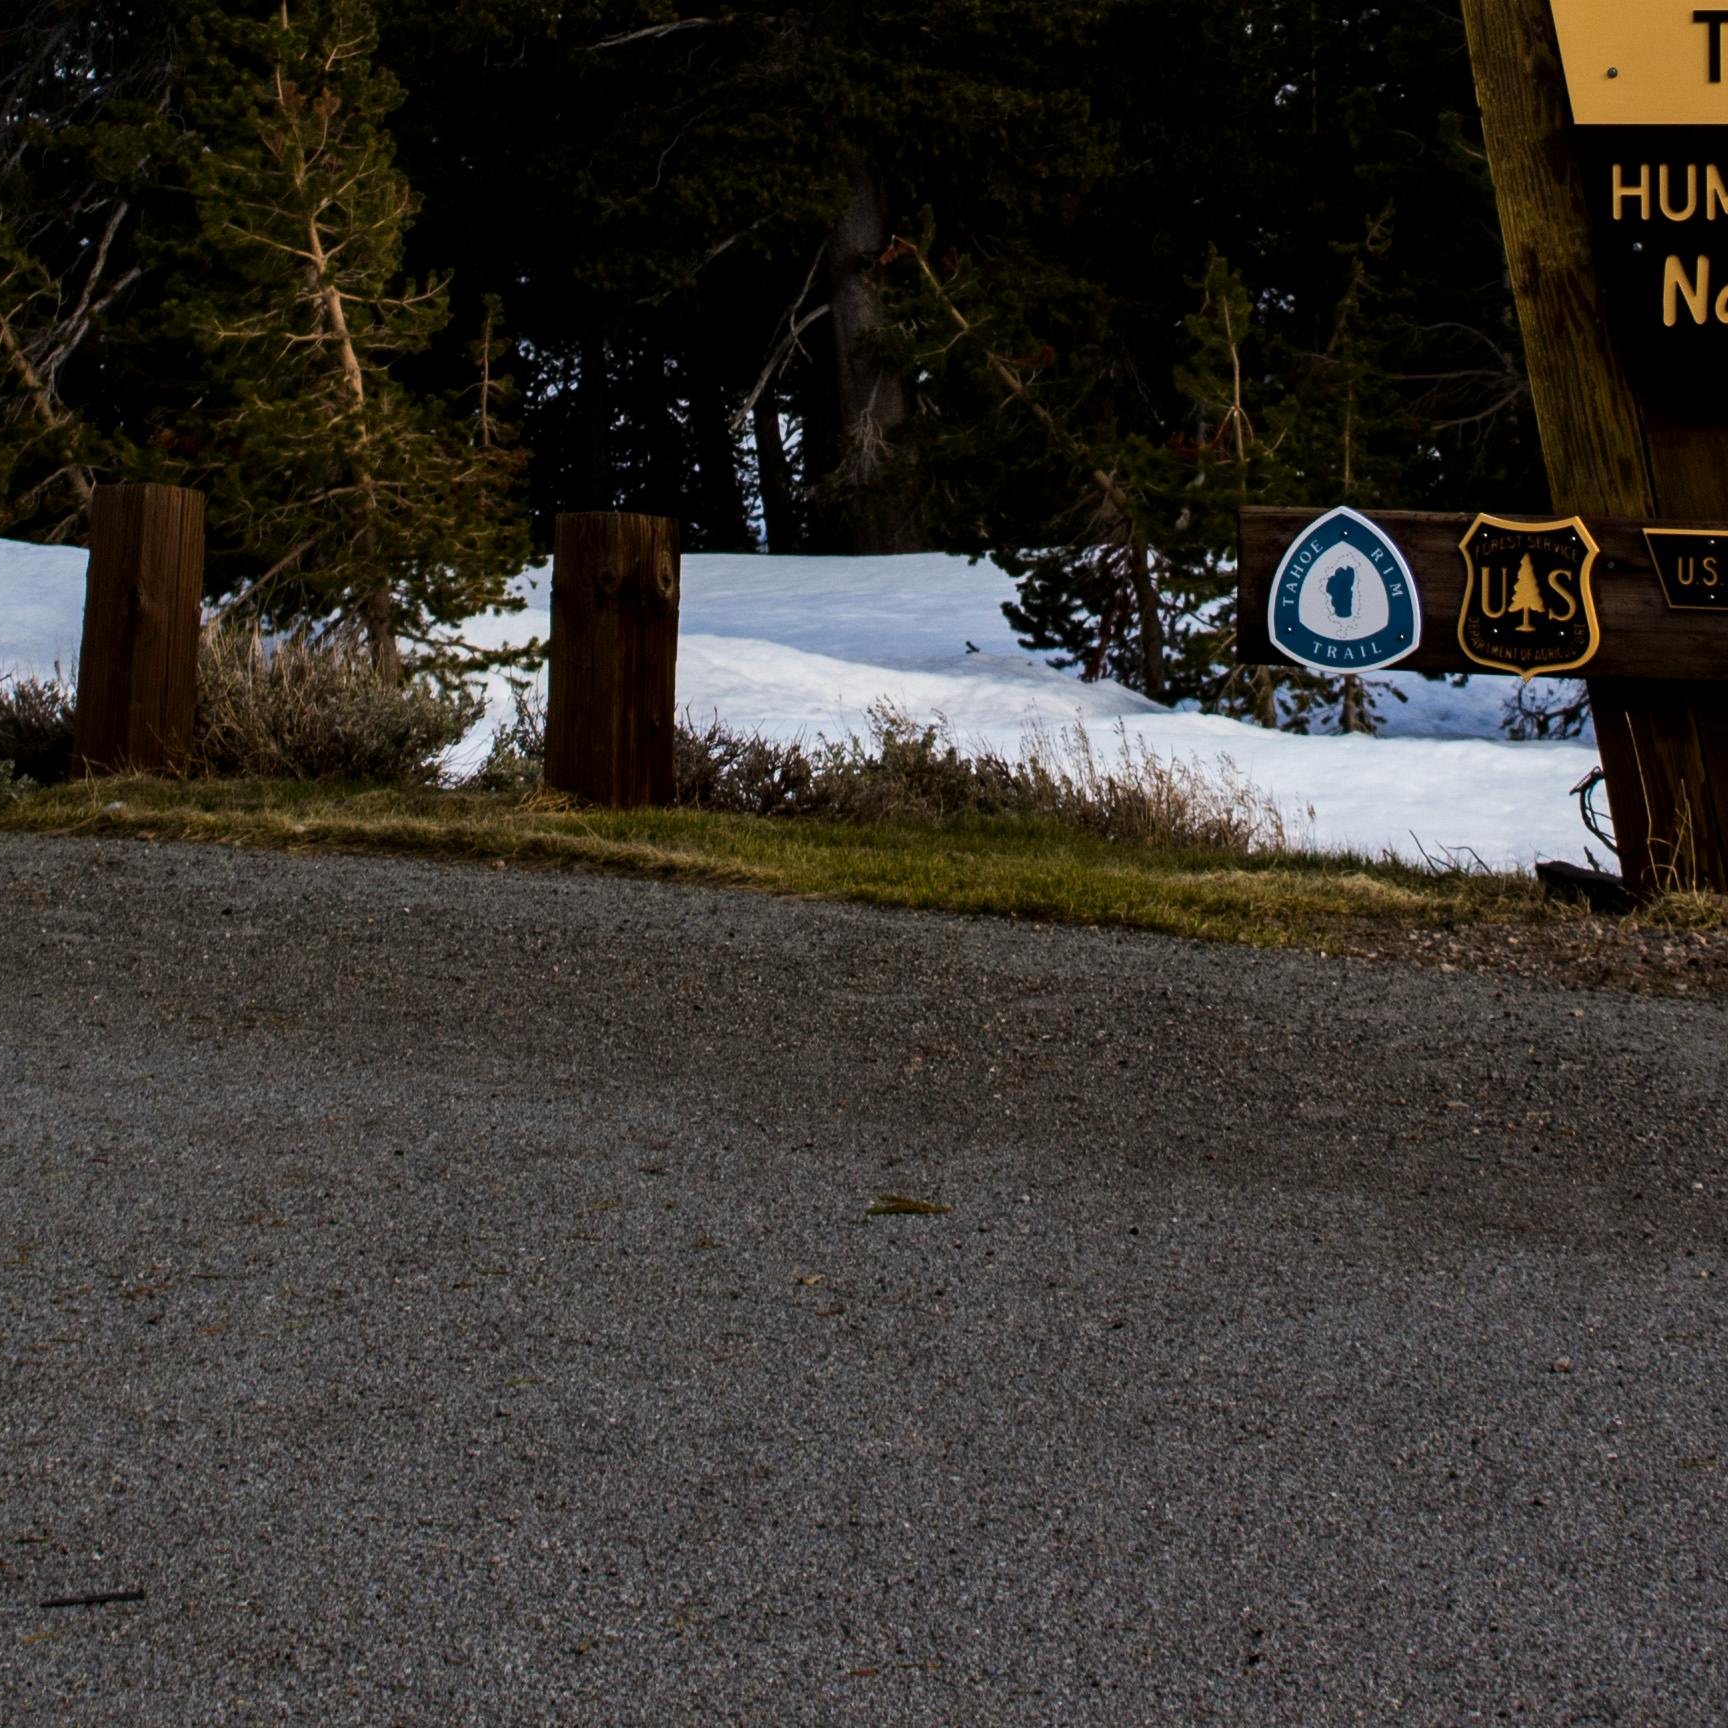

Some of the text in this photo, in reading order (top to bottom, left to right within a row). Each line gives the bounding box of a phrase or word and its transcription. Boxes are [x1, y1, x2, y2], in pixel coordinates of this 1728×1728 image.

[1474, 535, 1578, 562] FOREST SERVICE
[1282, 539, 1404, 607] TAHOE RIM
[1676, 555, 1725, 587] U.S.
[1313, 641, 1382, 660] TRAIL
